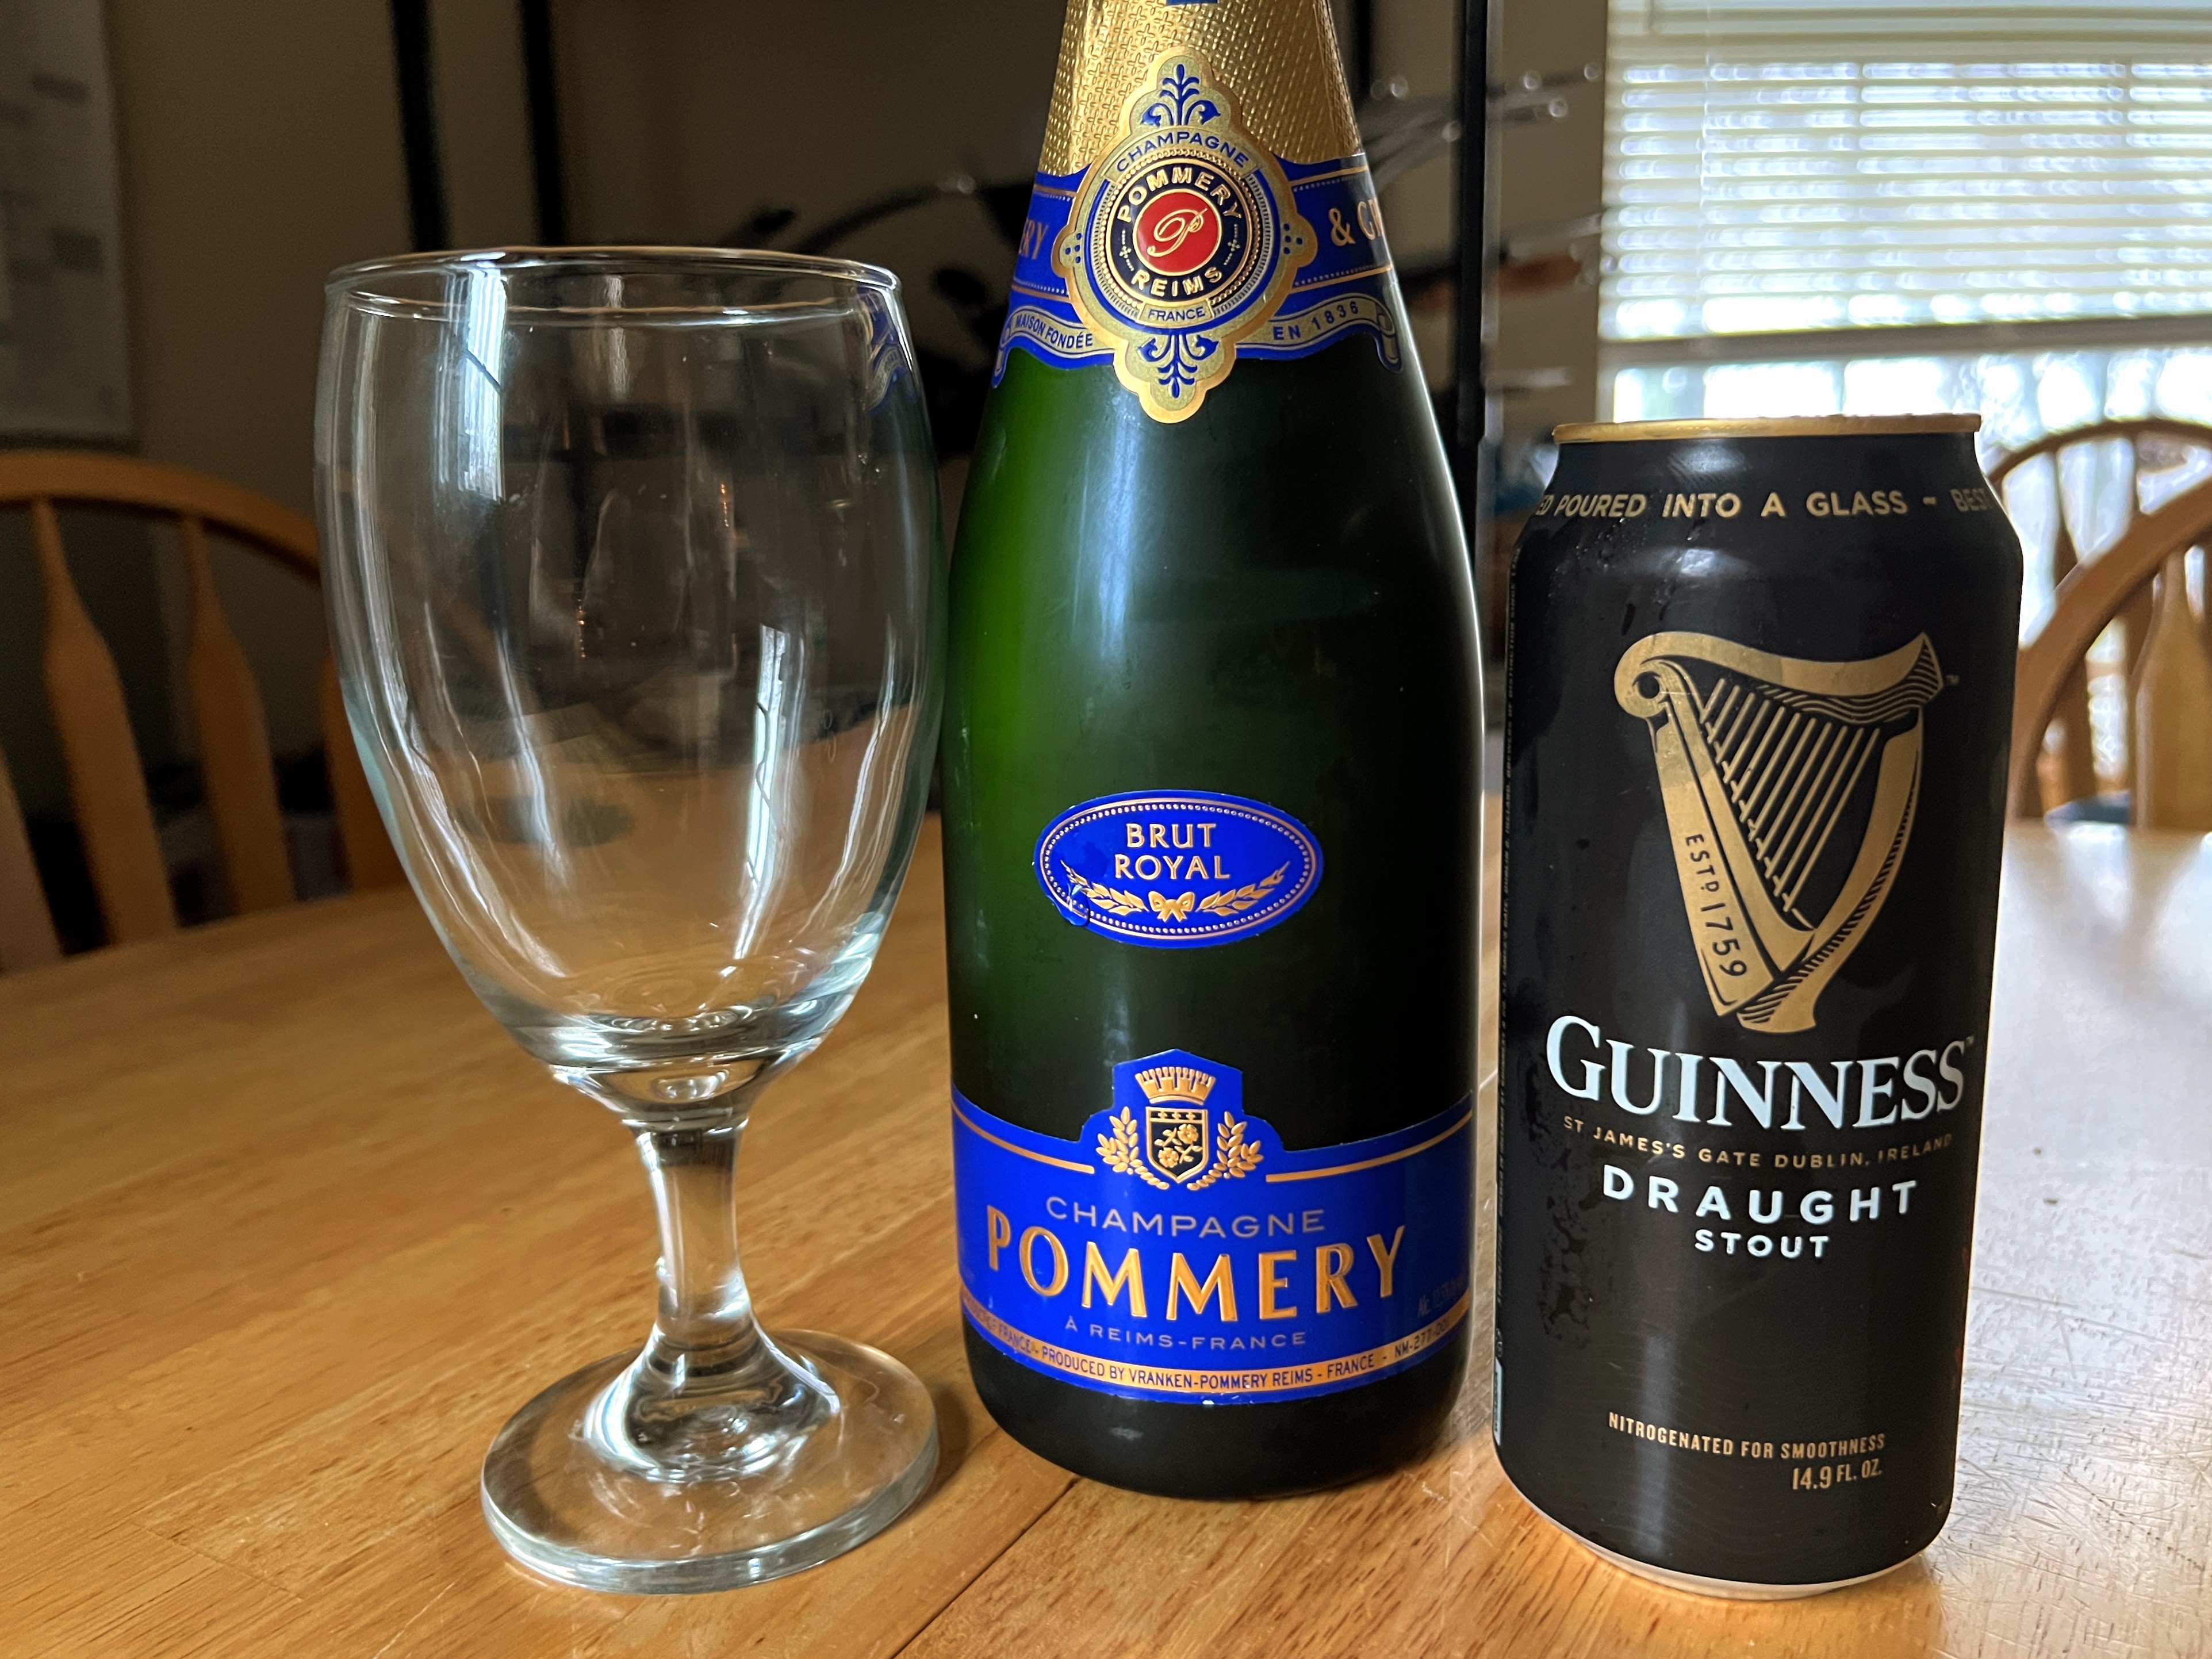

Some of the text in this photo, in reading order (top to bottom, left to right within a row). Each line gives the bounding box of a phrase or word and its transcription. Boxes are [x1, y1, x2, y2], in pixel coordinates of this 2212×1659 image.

[1117, 131, 1248, 171] CHAMPAGNE
[1117, 167, 1241, 223] POMMERY
[1329, 208, 1356, 246] &
[1131, 267, 1222, 297] REIMS
[1015, 301, 1358, 349] MAISON FONDÉE EN 1836
[1148, 306, 1205, 321] FRANCE
[1554, 494, 1647, 517] POURED
[1662, 492, 1742, 518] INTO
[1761, 493, 1786, 516] A
[1807, 491, 1908, 516] GLASS
[1126, 823, 1217, 849] BRUT
[1114, 853, 1230, 880] ROYAL
[1700, 902, 1747, 976] 1759
[1546, 1016, 1966, 1131] GUINNESS
[1564, 1116, 1953, 1168] ST JAMES'S GATE DUBLIN, IRELAND
[1603, 1165, 1917, 1225] DRAUGHT
[1045, 1197, 1326, 1239] CHAMPAGNE
[987, 1205, 1406, 1323] POMMERY
[1695, 1229, 1830, 1258] STOUT
[1065, 1315, 1306, 1350] À REIMS-FRANCE
[1042, 1347, 1105, 1377] PRODUCED
[1109, 1366, 1125, 1380] BY
[1129, 1368, 1267, 1389] VRANKEN-POMMERY
[1272, 1371, 1313, 1387] REIMS
[1327, 1354, 1375, 1379] FRANCE
[1608, 1412, 1885, 1459] NITROGENATED FOR SMOOTHNESS
[1792, 1459, 1883, 1490] 14.9 FL. OZ.
